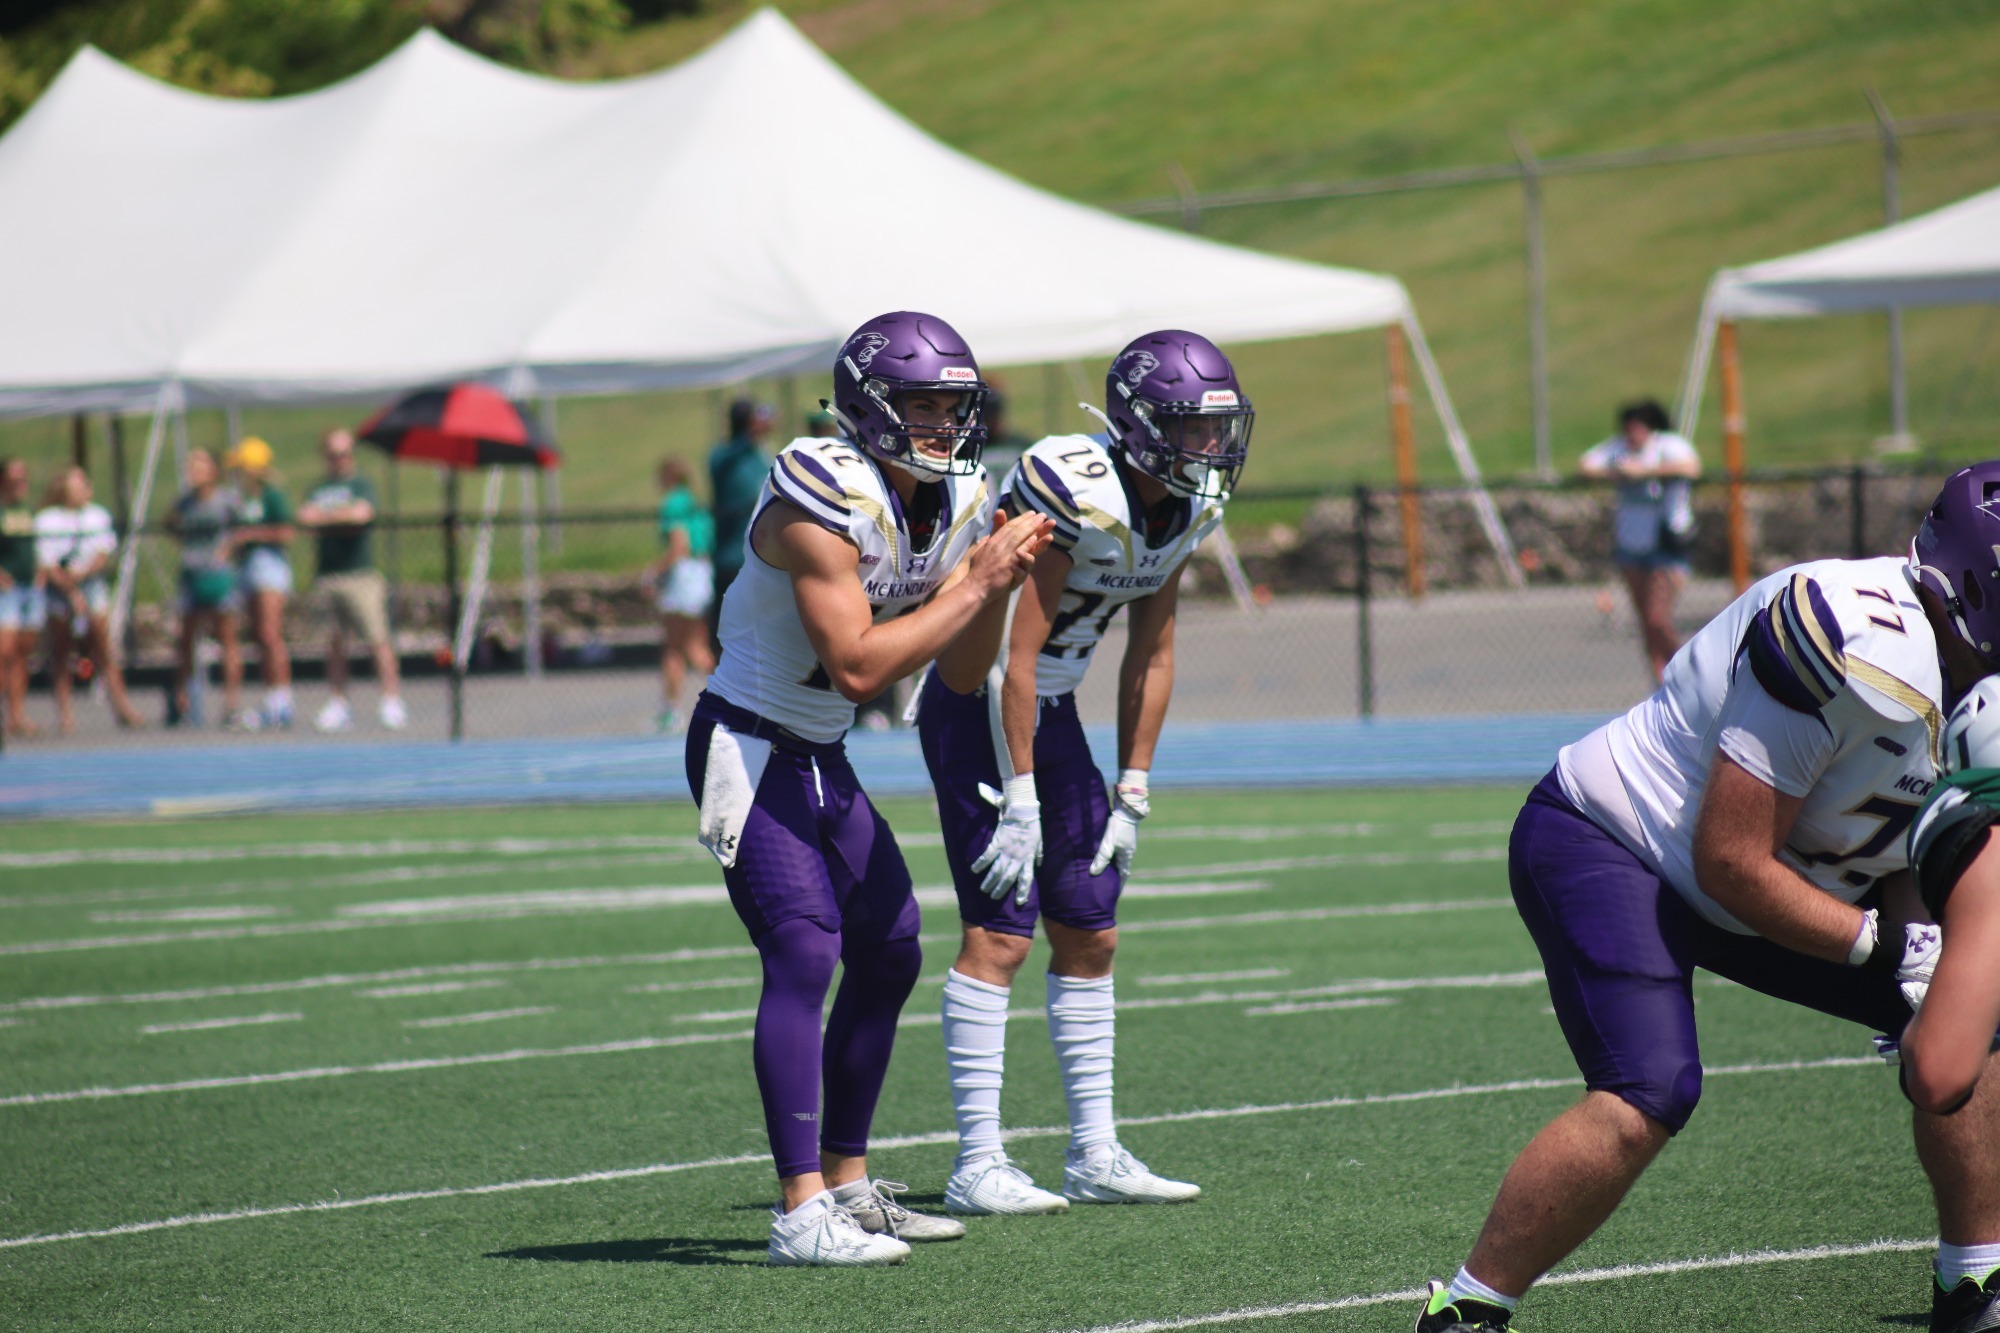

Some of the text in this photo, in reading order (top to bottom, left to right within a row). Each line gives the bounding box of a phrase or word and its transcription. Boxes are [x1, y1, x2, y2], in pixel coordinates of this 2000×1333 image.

[947, 370, 974, 378] Riddell
[1207, 394, 1234, 402] Riddell
[1852, 586, 1908, 637] 77
[1893, 774, 1935, 796] MCK
